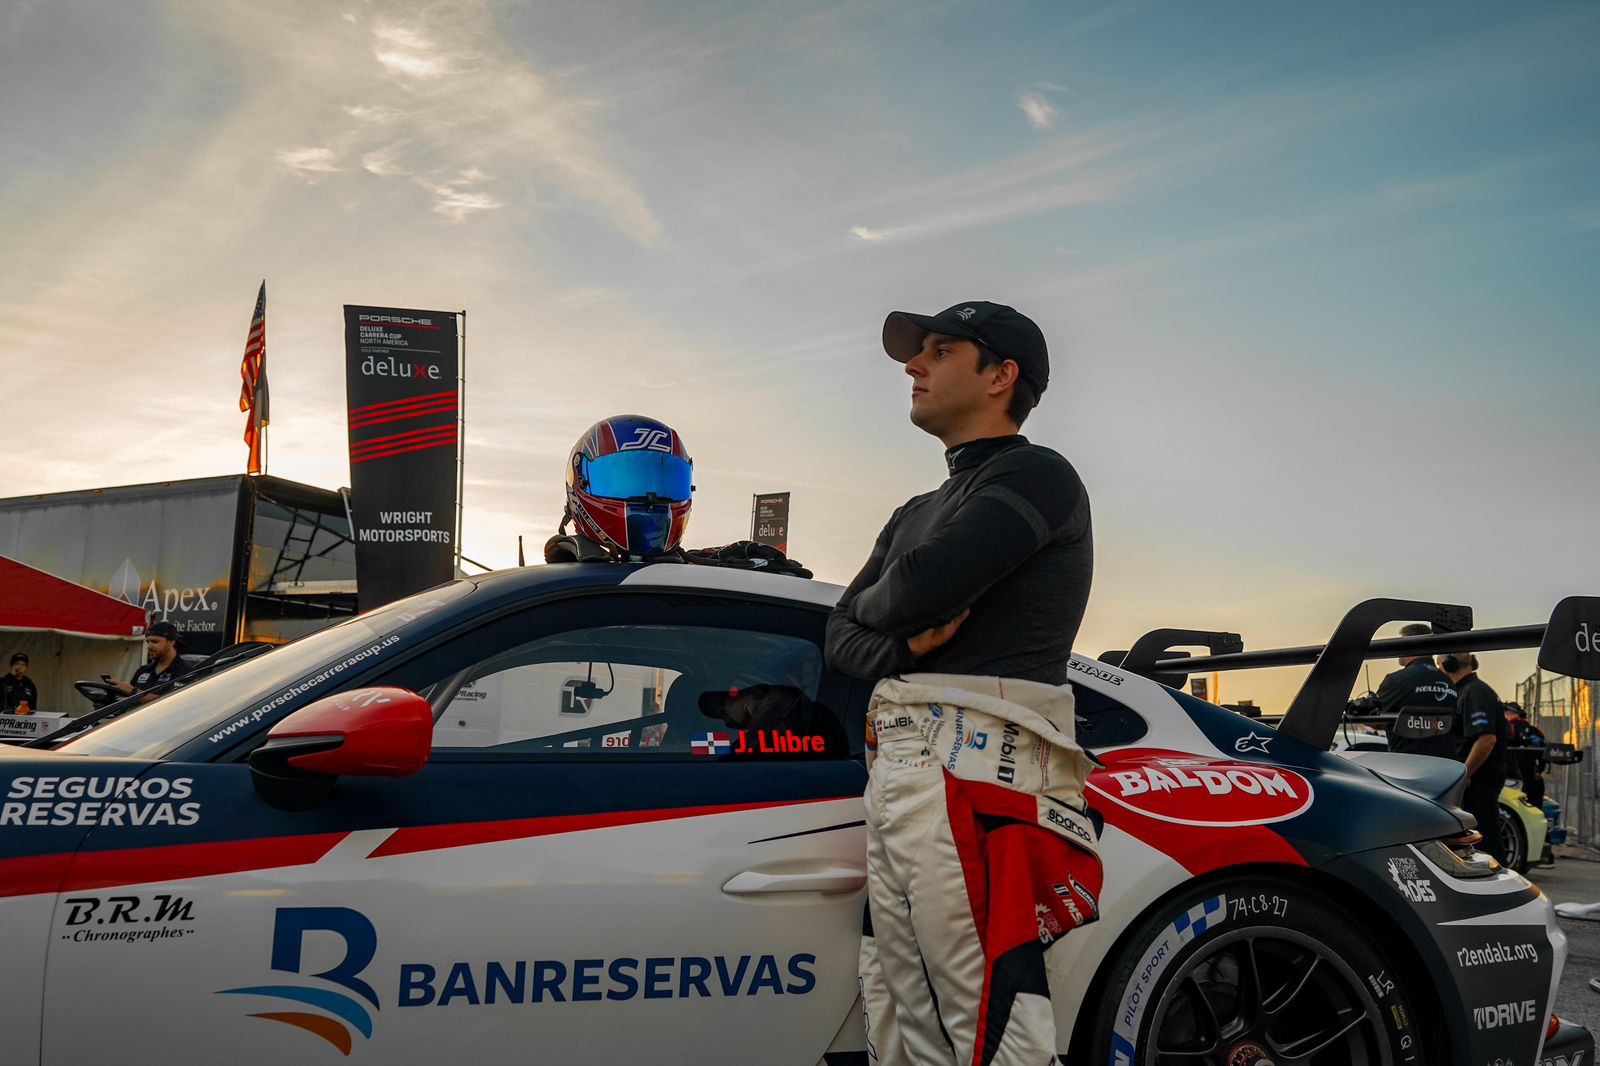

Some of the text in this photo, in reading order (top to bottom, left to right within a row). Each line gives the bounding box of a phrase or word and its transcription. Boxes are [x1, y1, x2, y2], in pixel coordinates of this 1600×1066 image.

[359, 314, 432, 326] PORSCHE
[360, 331, 389, 339] CARRERA
[361, 356, 440, 379] deluxe
[380, 511, 433, 524] WRIGHT
[360, 528, 450, 544] MOTORSPORTS
[758, 524, 784, 537] deluxe
[142, 579, 210, 622] Apex
[187, 619, 217, 632] Factor
[208, 634, 400, 744] www.porschecarreracup.us
[1407, 716, 1444, 730] deluxe
[735, 729, 825, 753] J. Llibre
[947, 706, 966, 770] ANRESERVAS
[1000, 721, 1020, 764] Mobil
[7, 776, 194, 799] SEGUROS
[1109, 766, 1299, 799] BALDOM
[0, 802, 201, 826] RESERVAS
[1047, 808, 1093, 843] sparco
[1456, 942, 1539, 968] r2endalz.org
[398, 952, 816, 1008] BANRESERVAS
[1124, 939, 1170, 1027] PILOT SPORT
